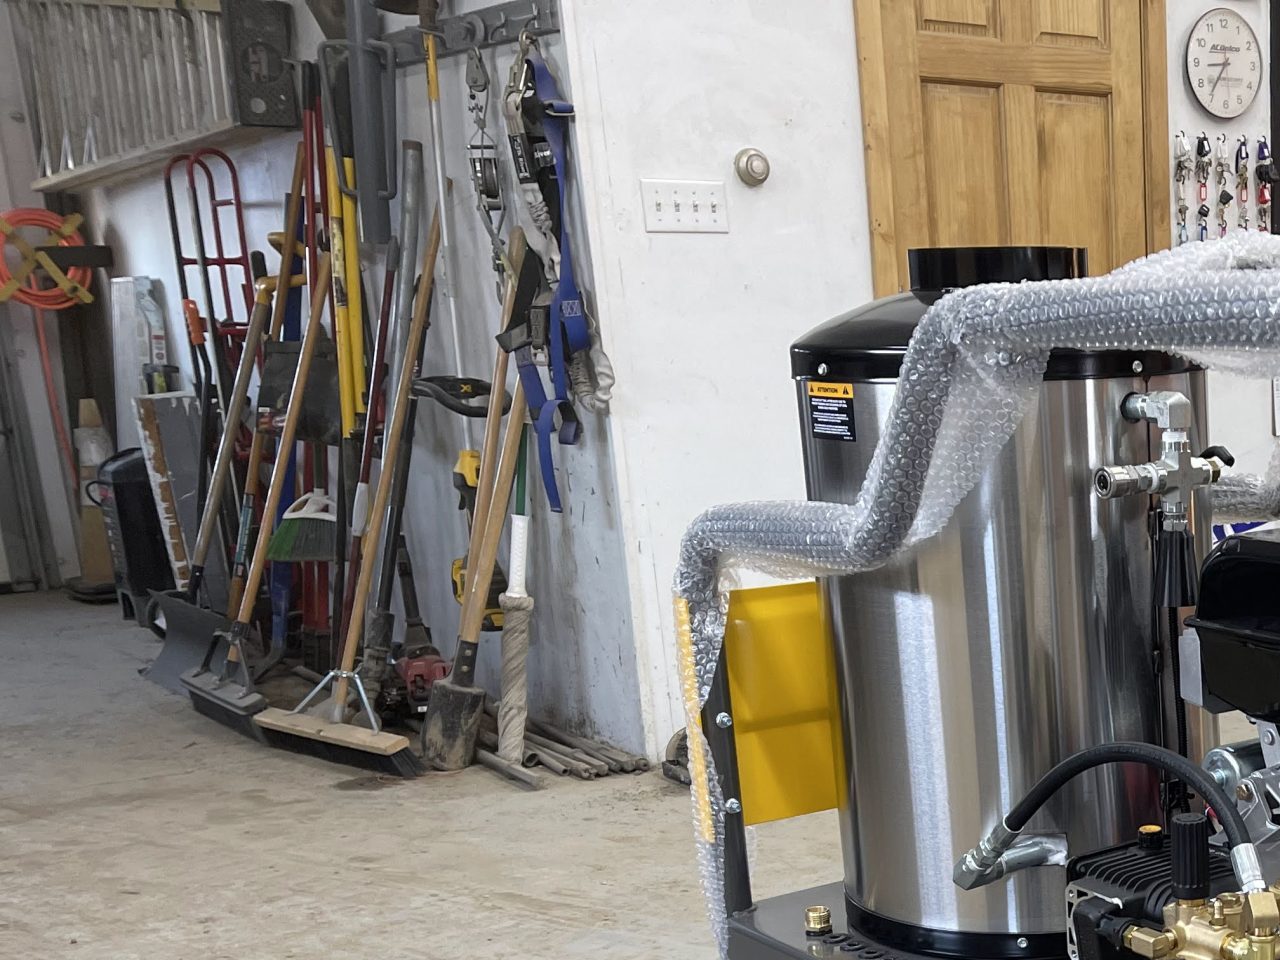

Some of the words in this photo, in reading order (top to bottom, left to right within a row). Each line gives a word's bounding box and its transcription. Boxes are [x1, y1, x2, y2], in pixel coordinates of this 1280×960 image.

[1207, 24, 1214, 32] 11
[1219, 19, 1228, 28] 12
[1236, 26, 1240, 35] 1
[1196, 38, 1206, 47] 10
[1246, 41, 1251, 50] 2
[1194, 58, 1200, 67] 9
[1250, 62, 1255, 70] 3
[1198, 79, 1204, 88] 8
[1209, 94, 1214, 103] 7
[1237, 95, 1242, 104] 5
[1223, 100, 1229, 109] 6
